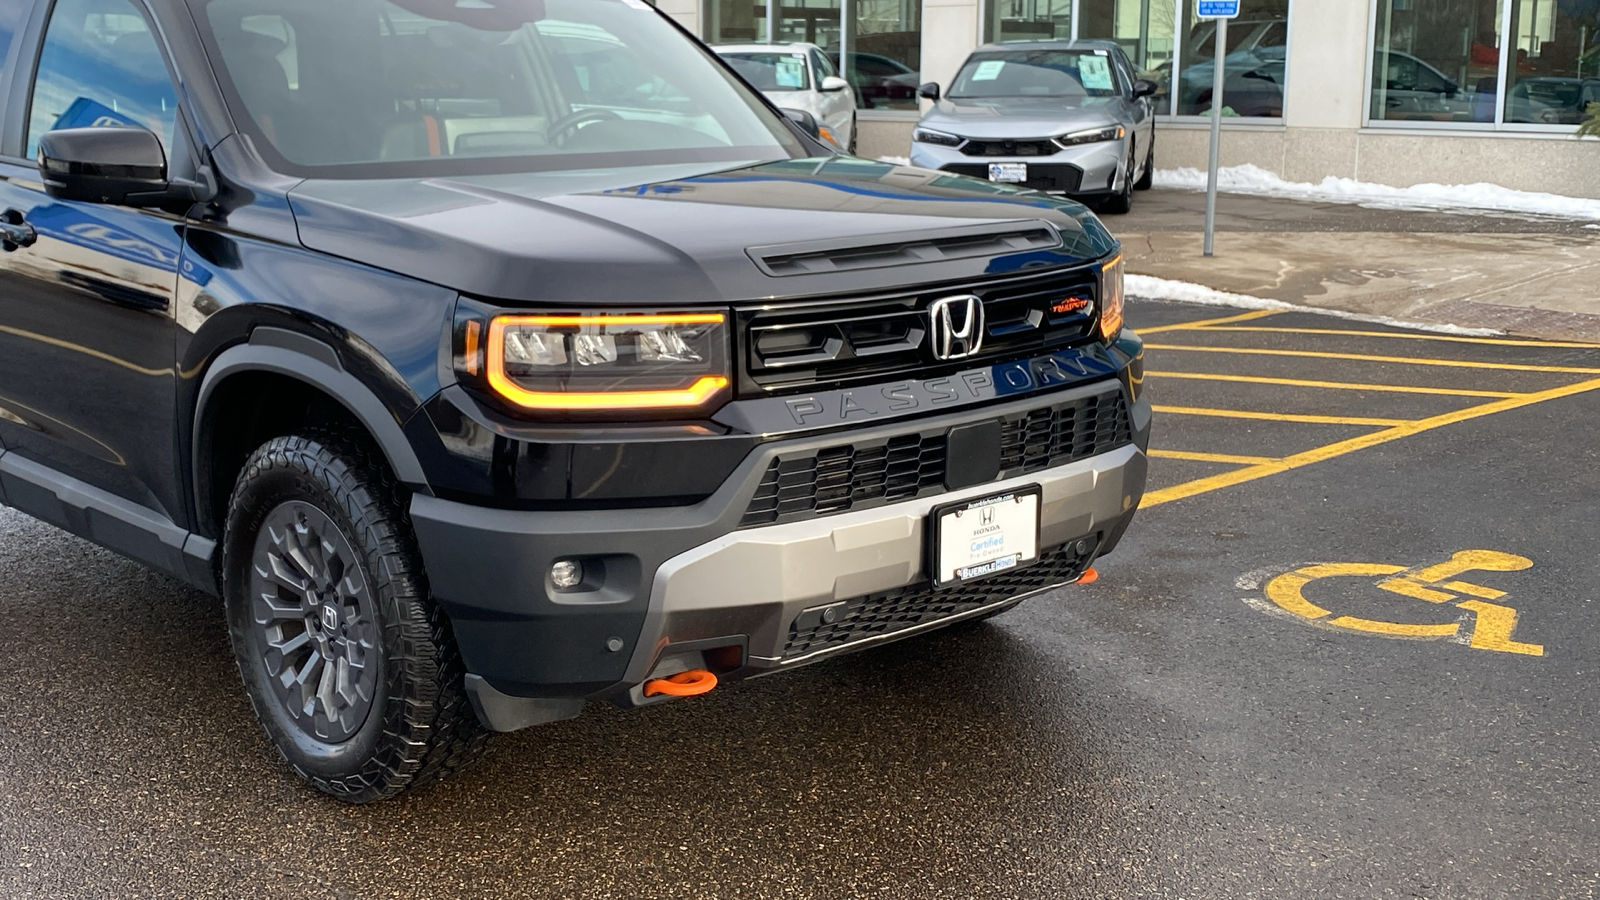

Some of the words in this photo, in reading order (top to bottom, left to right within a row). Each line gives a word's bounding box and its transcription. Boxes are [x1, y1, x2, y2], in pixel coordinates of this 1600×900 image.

[784, 350, 1092, 425] PASSPORT
[973, 524, 1001, 536] HONDA
[970, 535, 1004, 552] Certified
[962, 562, 996, 578] BUERKLE
[996, 558, 1015, 570] HONDA
